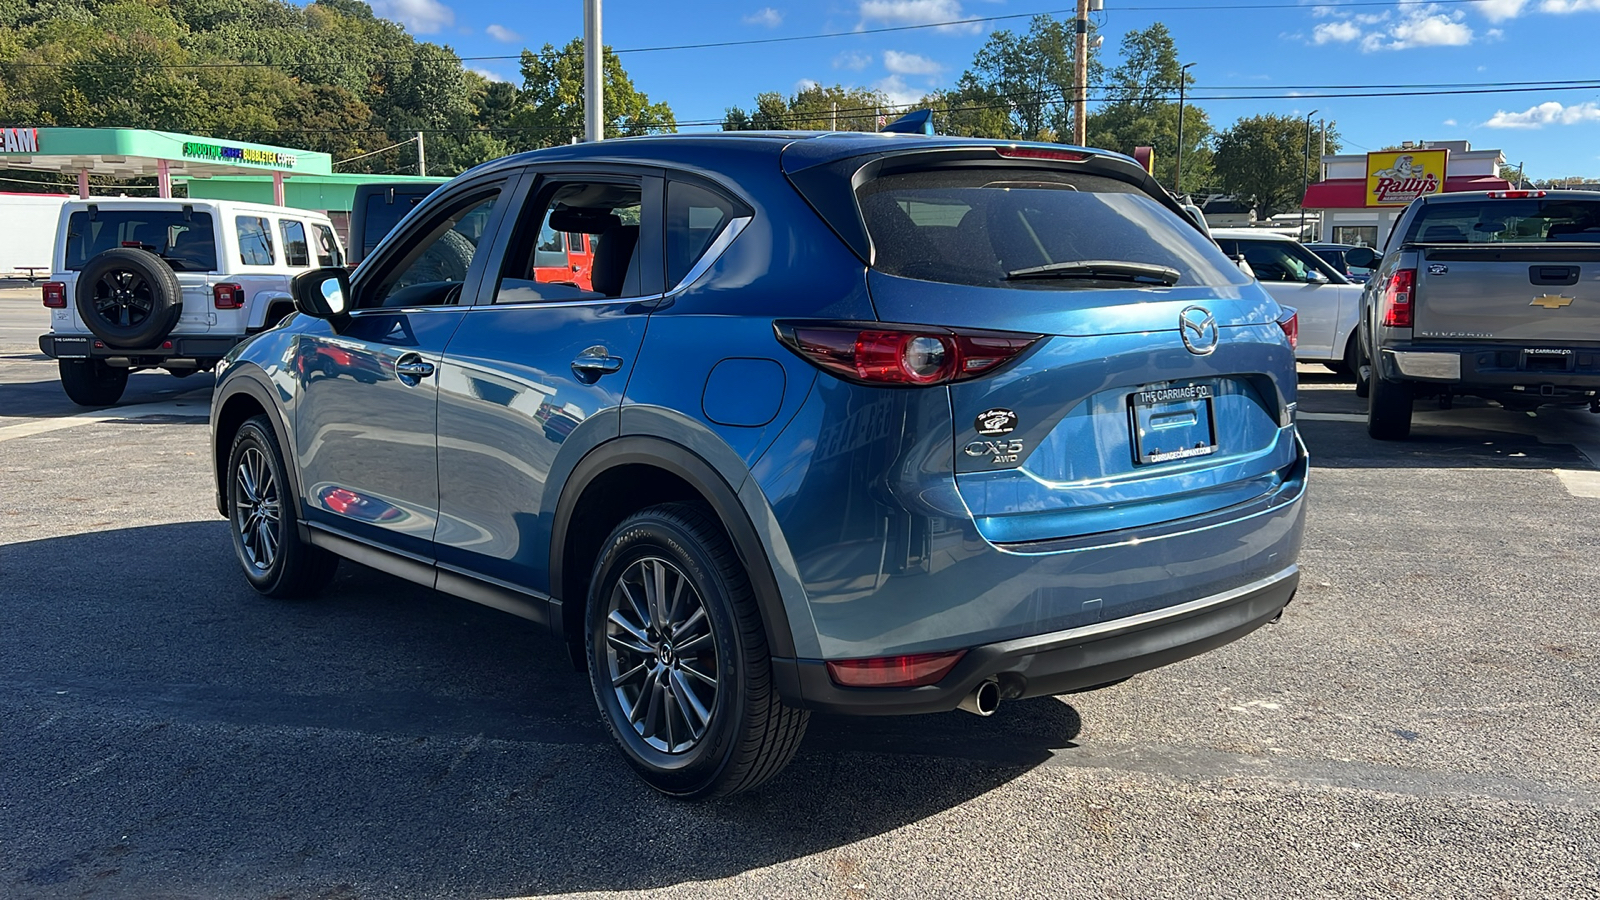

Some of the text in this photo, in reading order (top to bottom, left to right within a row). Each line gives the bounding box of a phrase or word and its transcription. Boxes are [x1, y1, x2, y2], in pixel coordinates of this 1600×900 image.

[184, 142, 222, 157] SMOOTHIE
[1374, 173, 1439, 201] Rally's
[1140, 385, 1209, 402] THE CARRIAGE CO.
[965, 439, 1024, 457] CX-5
[1151, 447, 1212, 462] CARRIAGECOMPANY.COM
[992, 454, 1018, 464] AWD
[667, 538, 695, 566] TOURING
